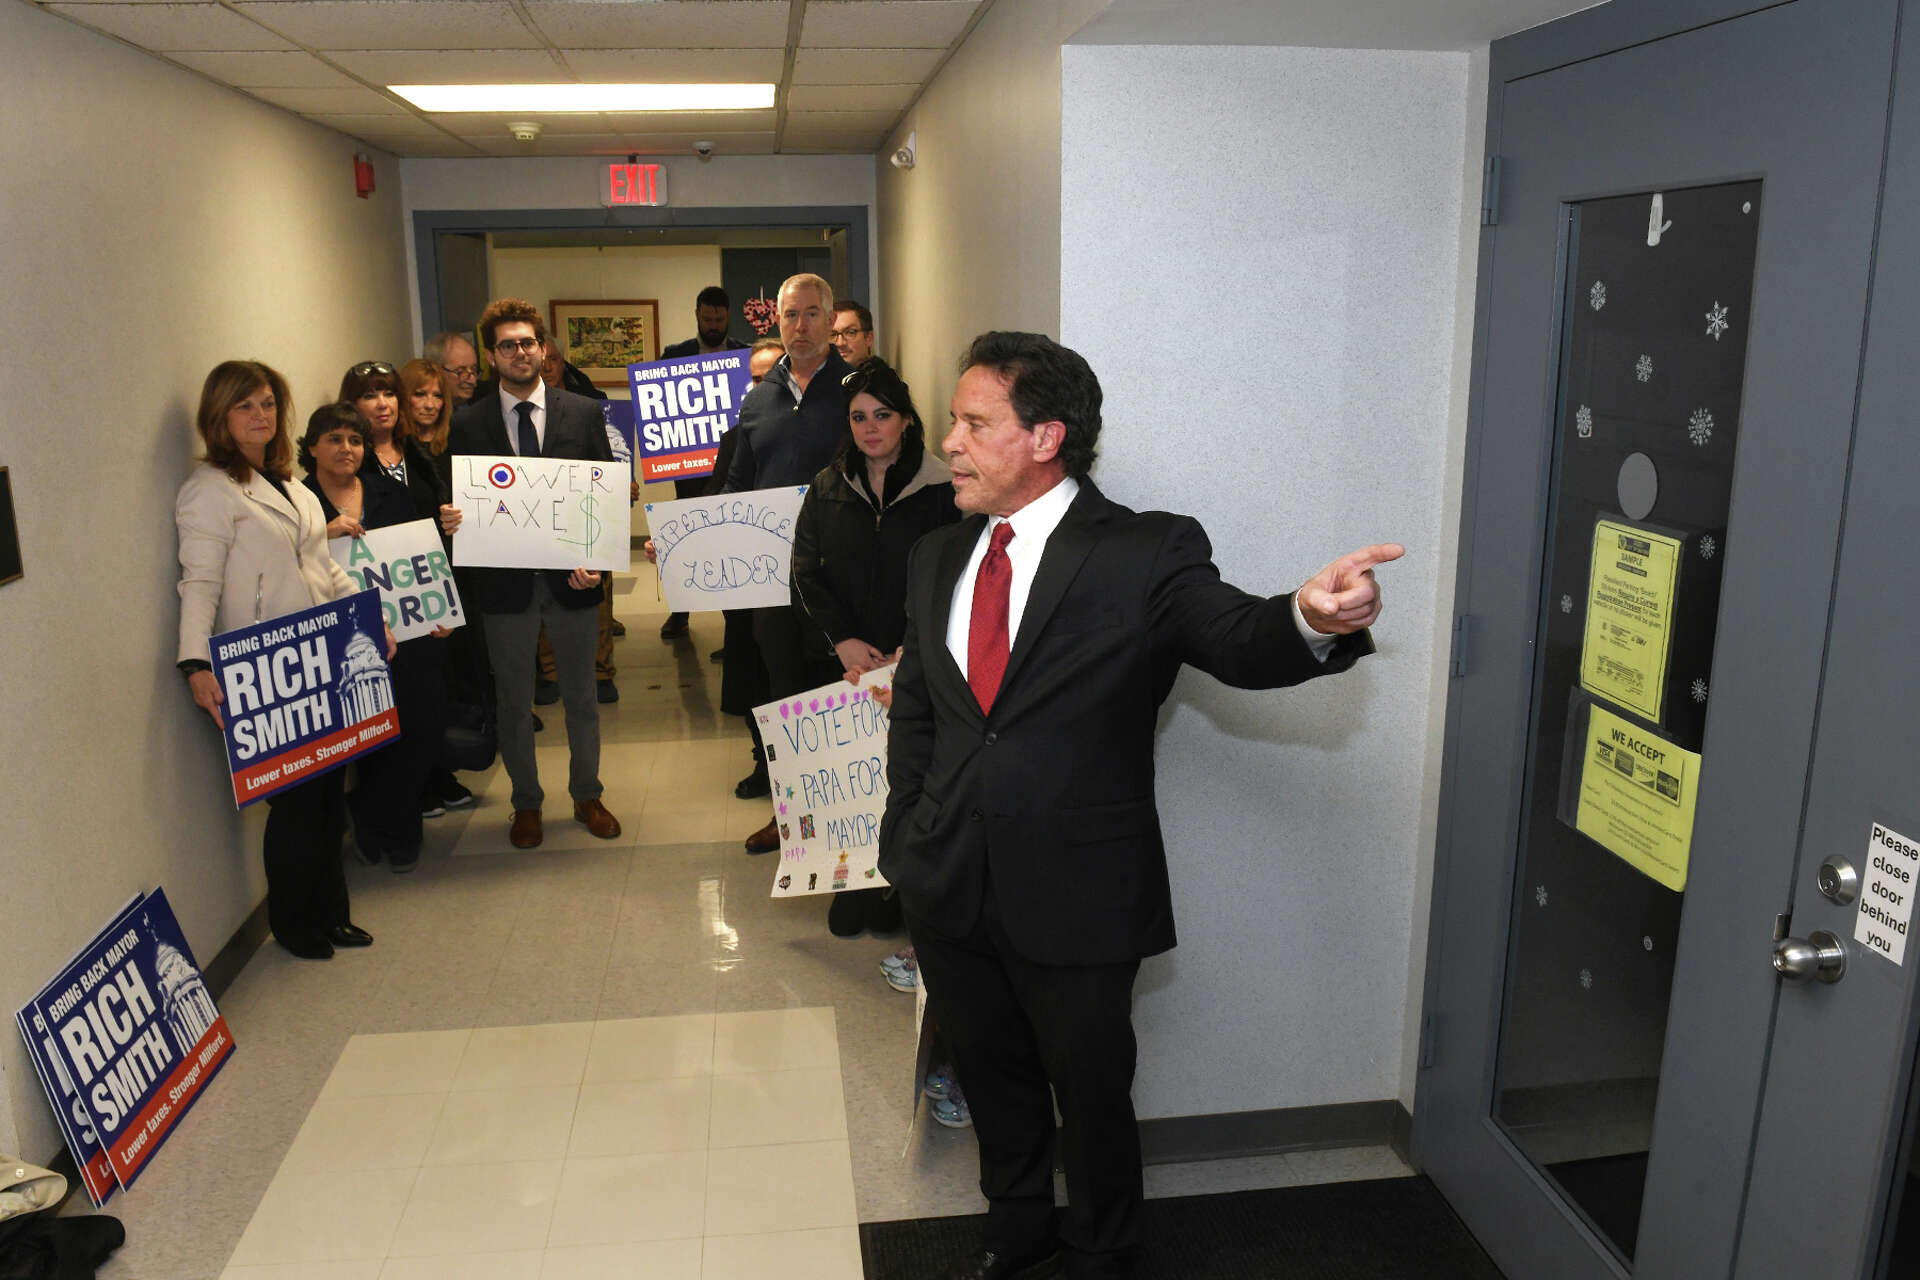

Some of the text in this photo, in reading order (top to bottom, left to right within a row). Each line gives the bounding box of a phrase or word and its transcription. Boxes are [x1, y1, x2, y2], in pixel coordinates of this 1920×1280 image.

[609, 163, 659, 204] EXIT
[634, 357, 741, 382] BRING BACK MAYOR
[637, 373, 732, 421] RICH
[643, 413, 729, 451] SMITH
[463, 458, 613, 493] LOWER
[651, 461, 681, 473] Lower
[683, 457, 712, 470] taxes.
[349, 537, 376, 567] A
[683, 554, 790, 592] LEADER
[219, 611, 339, 661] BRING BACK MAYOR
[223, 635, 333, 717] RICH
[233, 690, 333, 760] SMITH
[782, 699, 888, 755] VOTE FOR
[246, 719, 393, 791] Lower taxes. Stronger Milford.
[1611, 728, 1626, 745] WE
[1627, 737, 1666, 765] ACCEPT
[800, 756, 889, 809] PAPA FOR
[827, 813, 880, 851] MAYOR
[1872, 826, 1919, 861] Please
[1872, 856, 1910, 884] close
[1871, 880, 1904, 906] door
[1860, 898, 1907, 936] behind
[1866, 930, 1891, 953] you
[48, 985, 83, 1024] BRING
[79, 961, 109, 994] BACK
[105, 928, 140, 969] MAYOR
[60, 959, 156, 1085] RICH
[91, 1021, 173, 1133] SMITH
[120, 1031, 227, 1166] Lower taxes. Stronger Milford.
